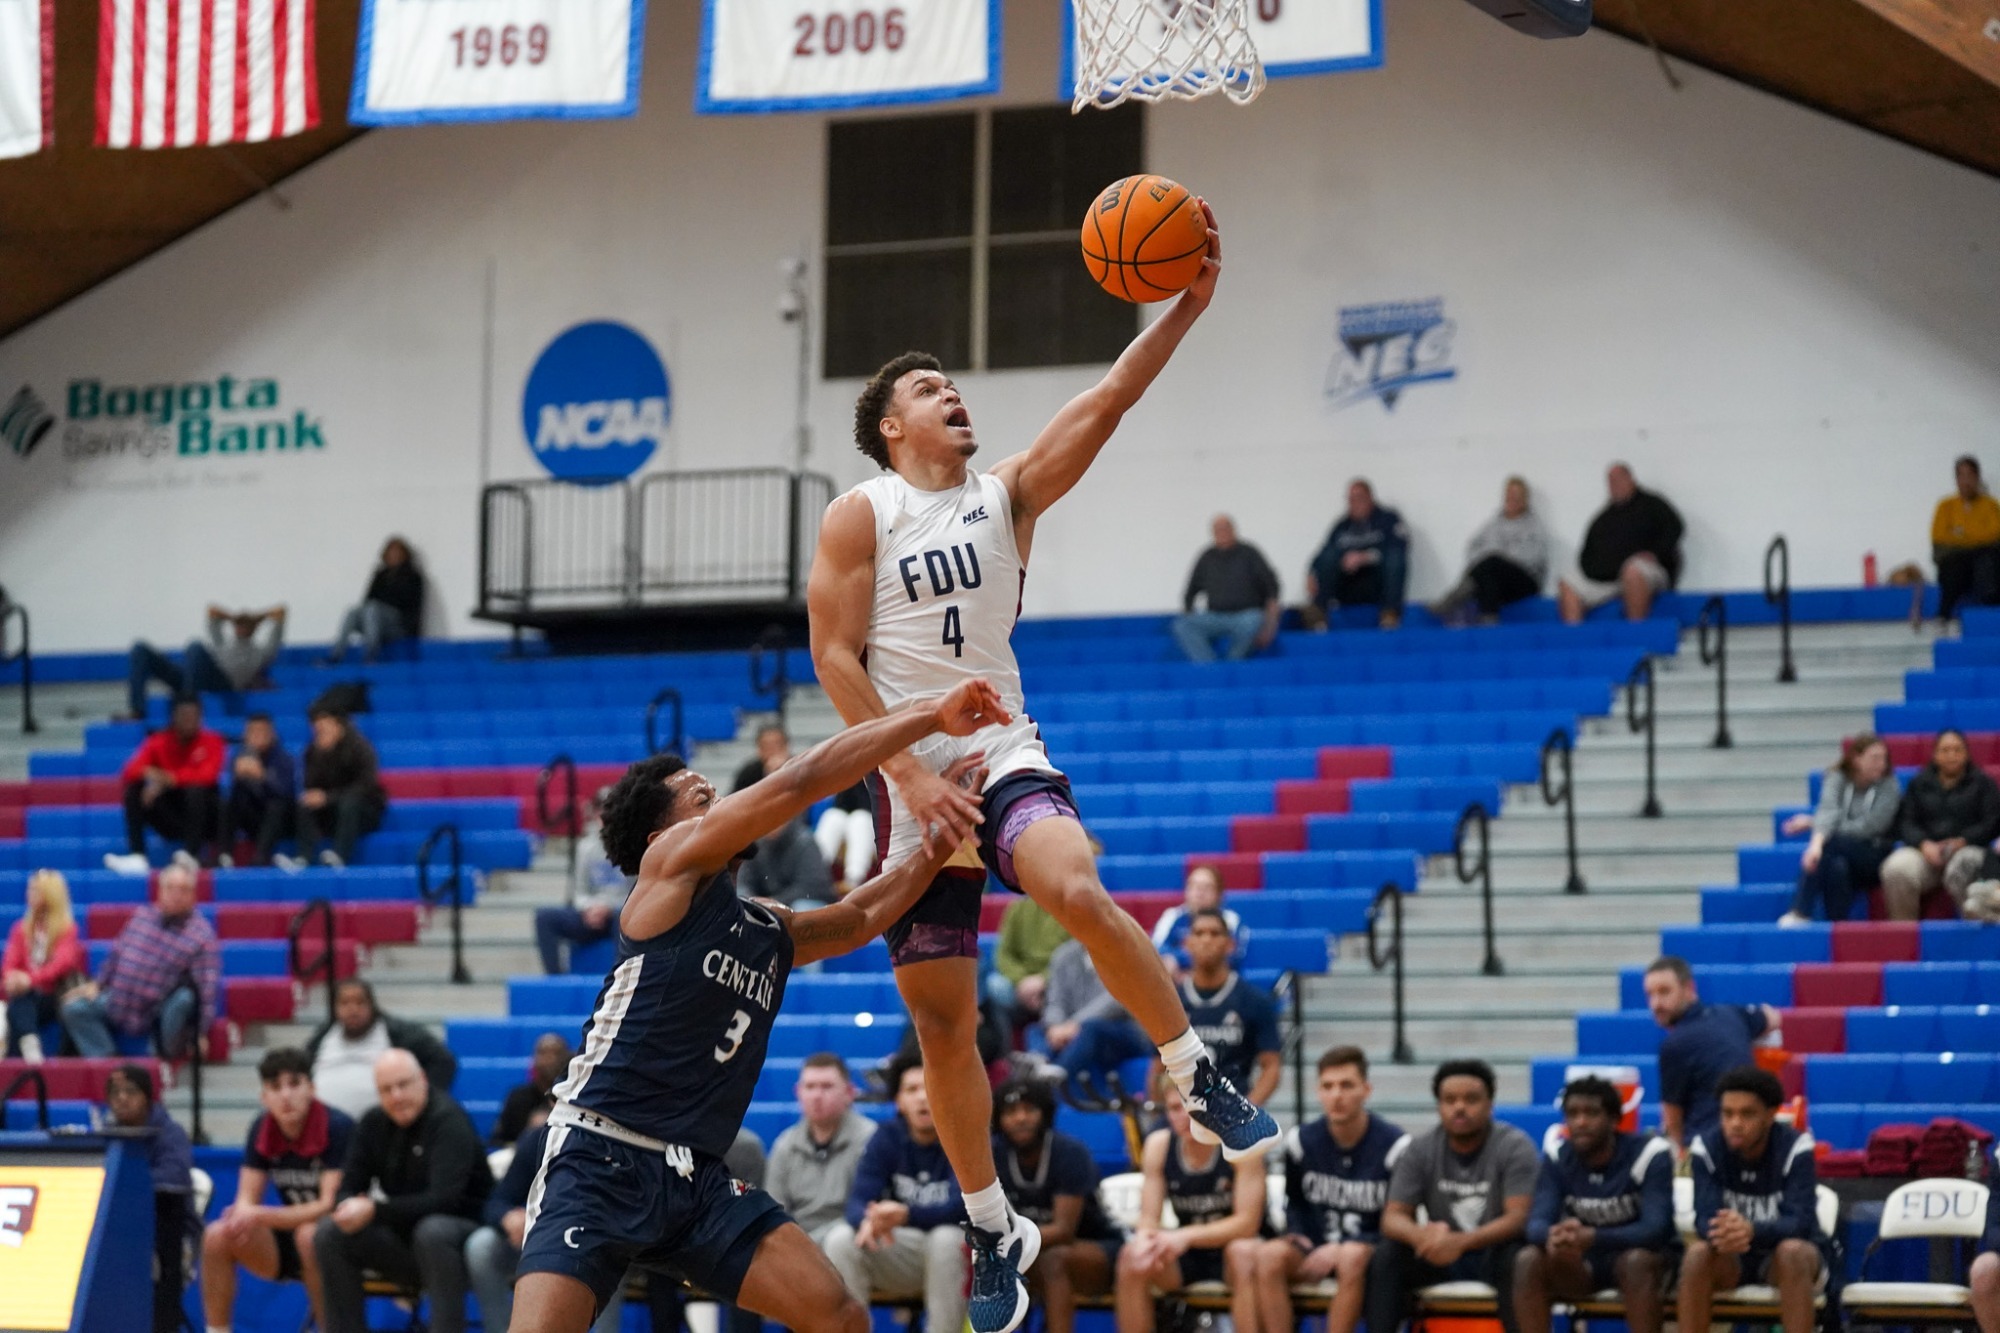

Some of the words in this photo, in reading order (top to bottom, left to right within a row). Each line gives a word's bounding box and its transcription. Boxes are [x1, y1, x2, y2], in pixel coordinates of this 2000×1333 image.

[450, 23, 549, 68] 1969
[794, 8, 906, 57] 2006
[1323, 320, 1457, 397] NEC
[66, 373, 278, 425] Bogota
[535, 397, 668, 451] NCAA
[178, 412, 325, 455] Bank
[962, 505, 986, 525] NEC
[899, 542, 982, 603] FDU
[942, 605, 965, 658] 4
[713, 1008, 752, 1064] 3
[1902, 1190, 1978, 1219] FDU
[563, 1226, 585, 1249] C
